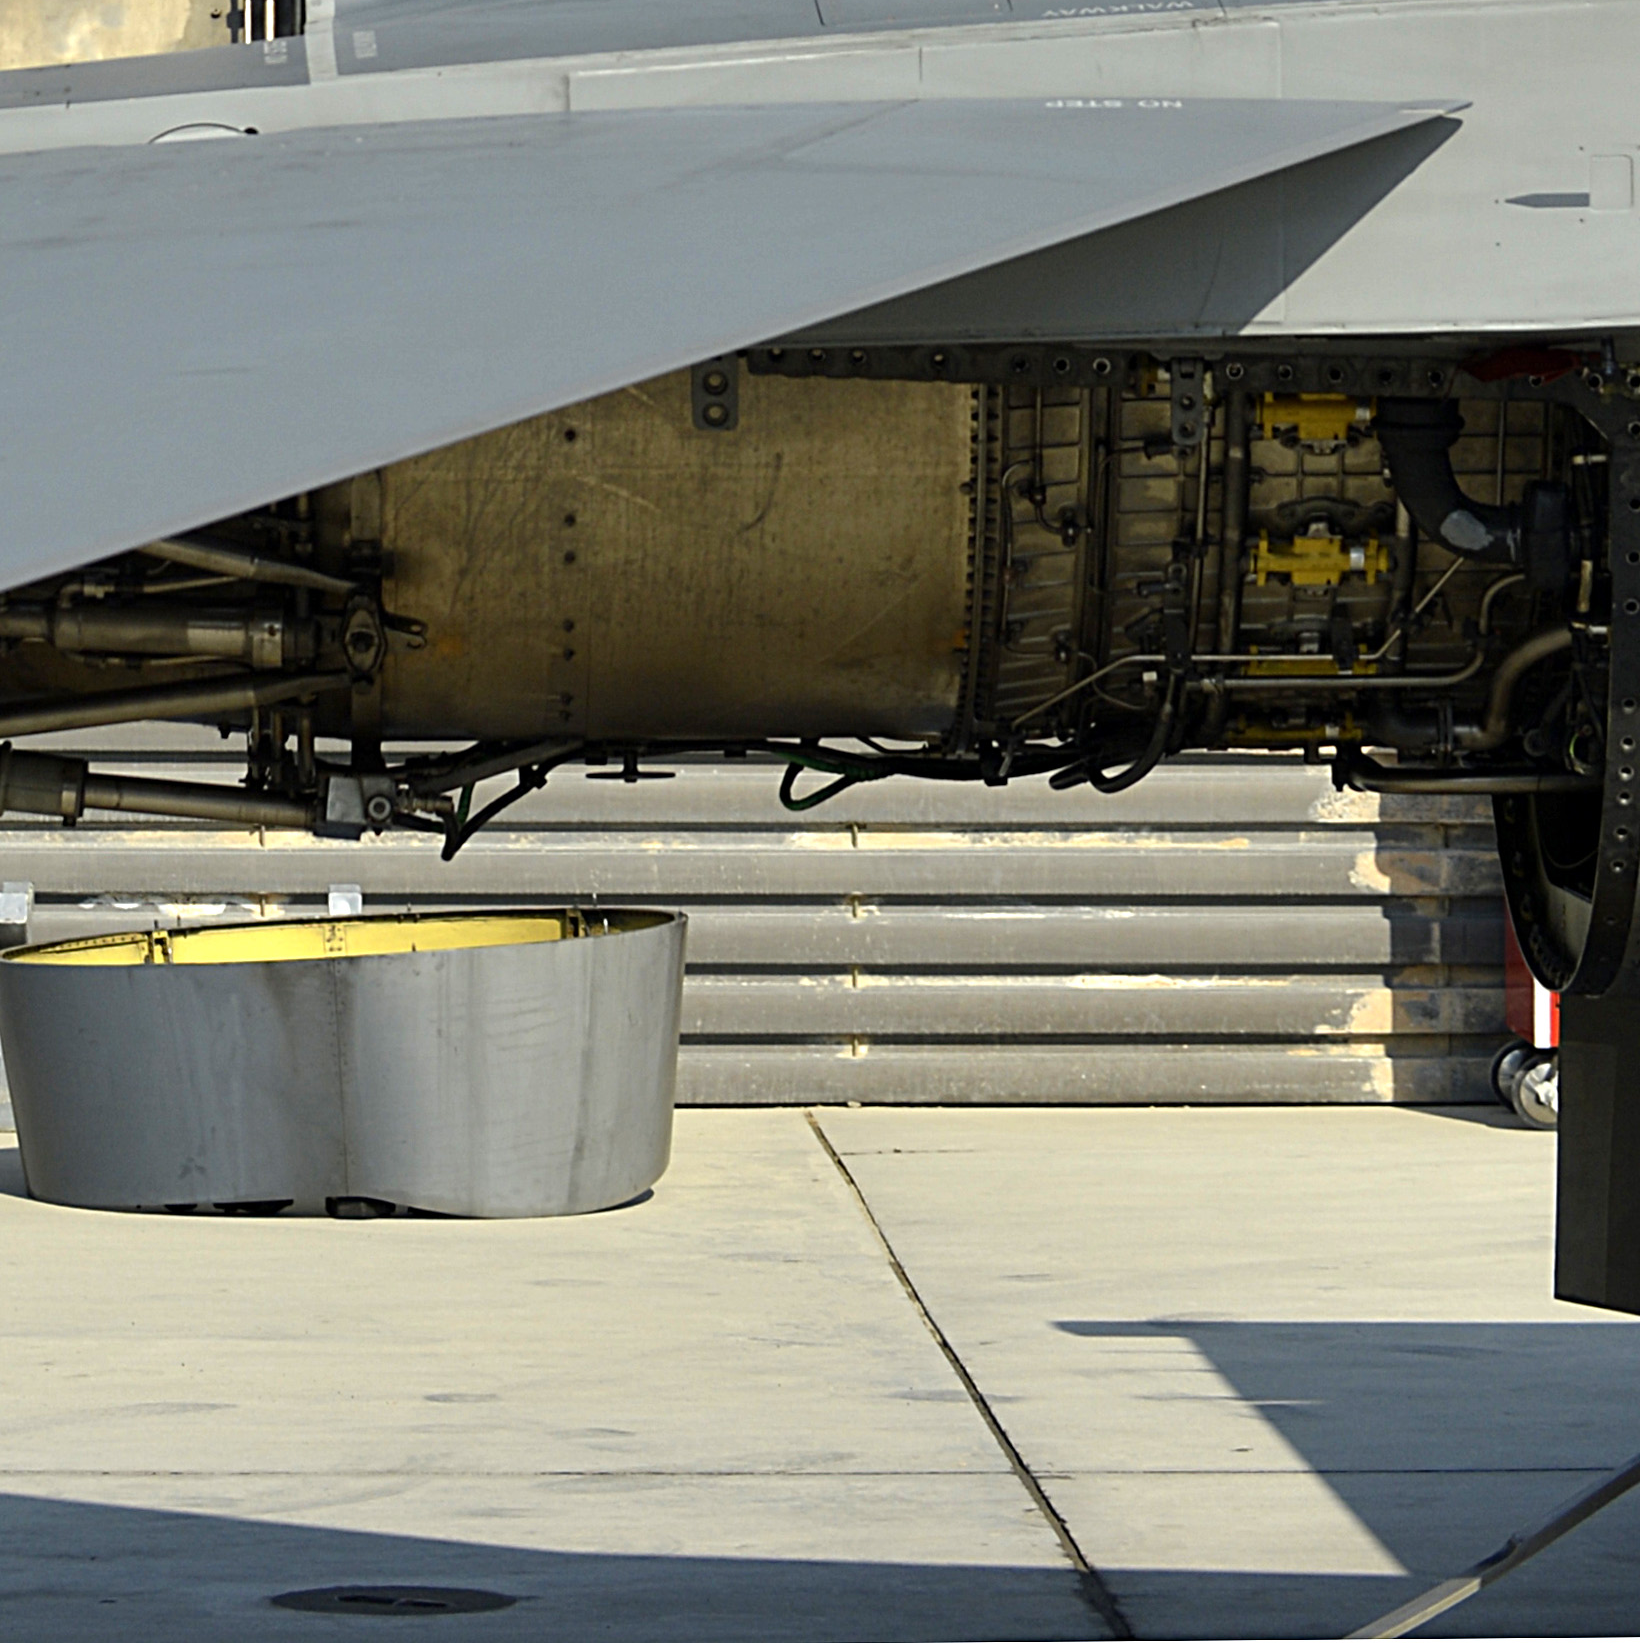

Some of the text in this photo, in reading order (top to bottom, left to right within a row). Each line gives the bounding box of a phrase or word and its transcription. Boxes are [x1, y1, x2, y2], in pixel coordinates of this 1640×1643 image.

[1042, 0, 1194, 16] WALKWAY
[1045, 99, 1182, 108] NO STEP
